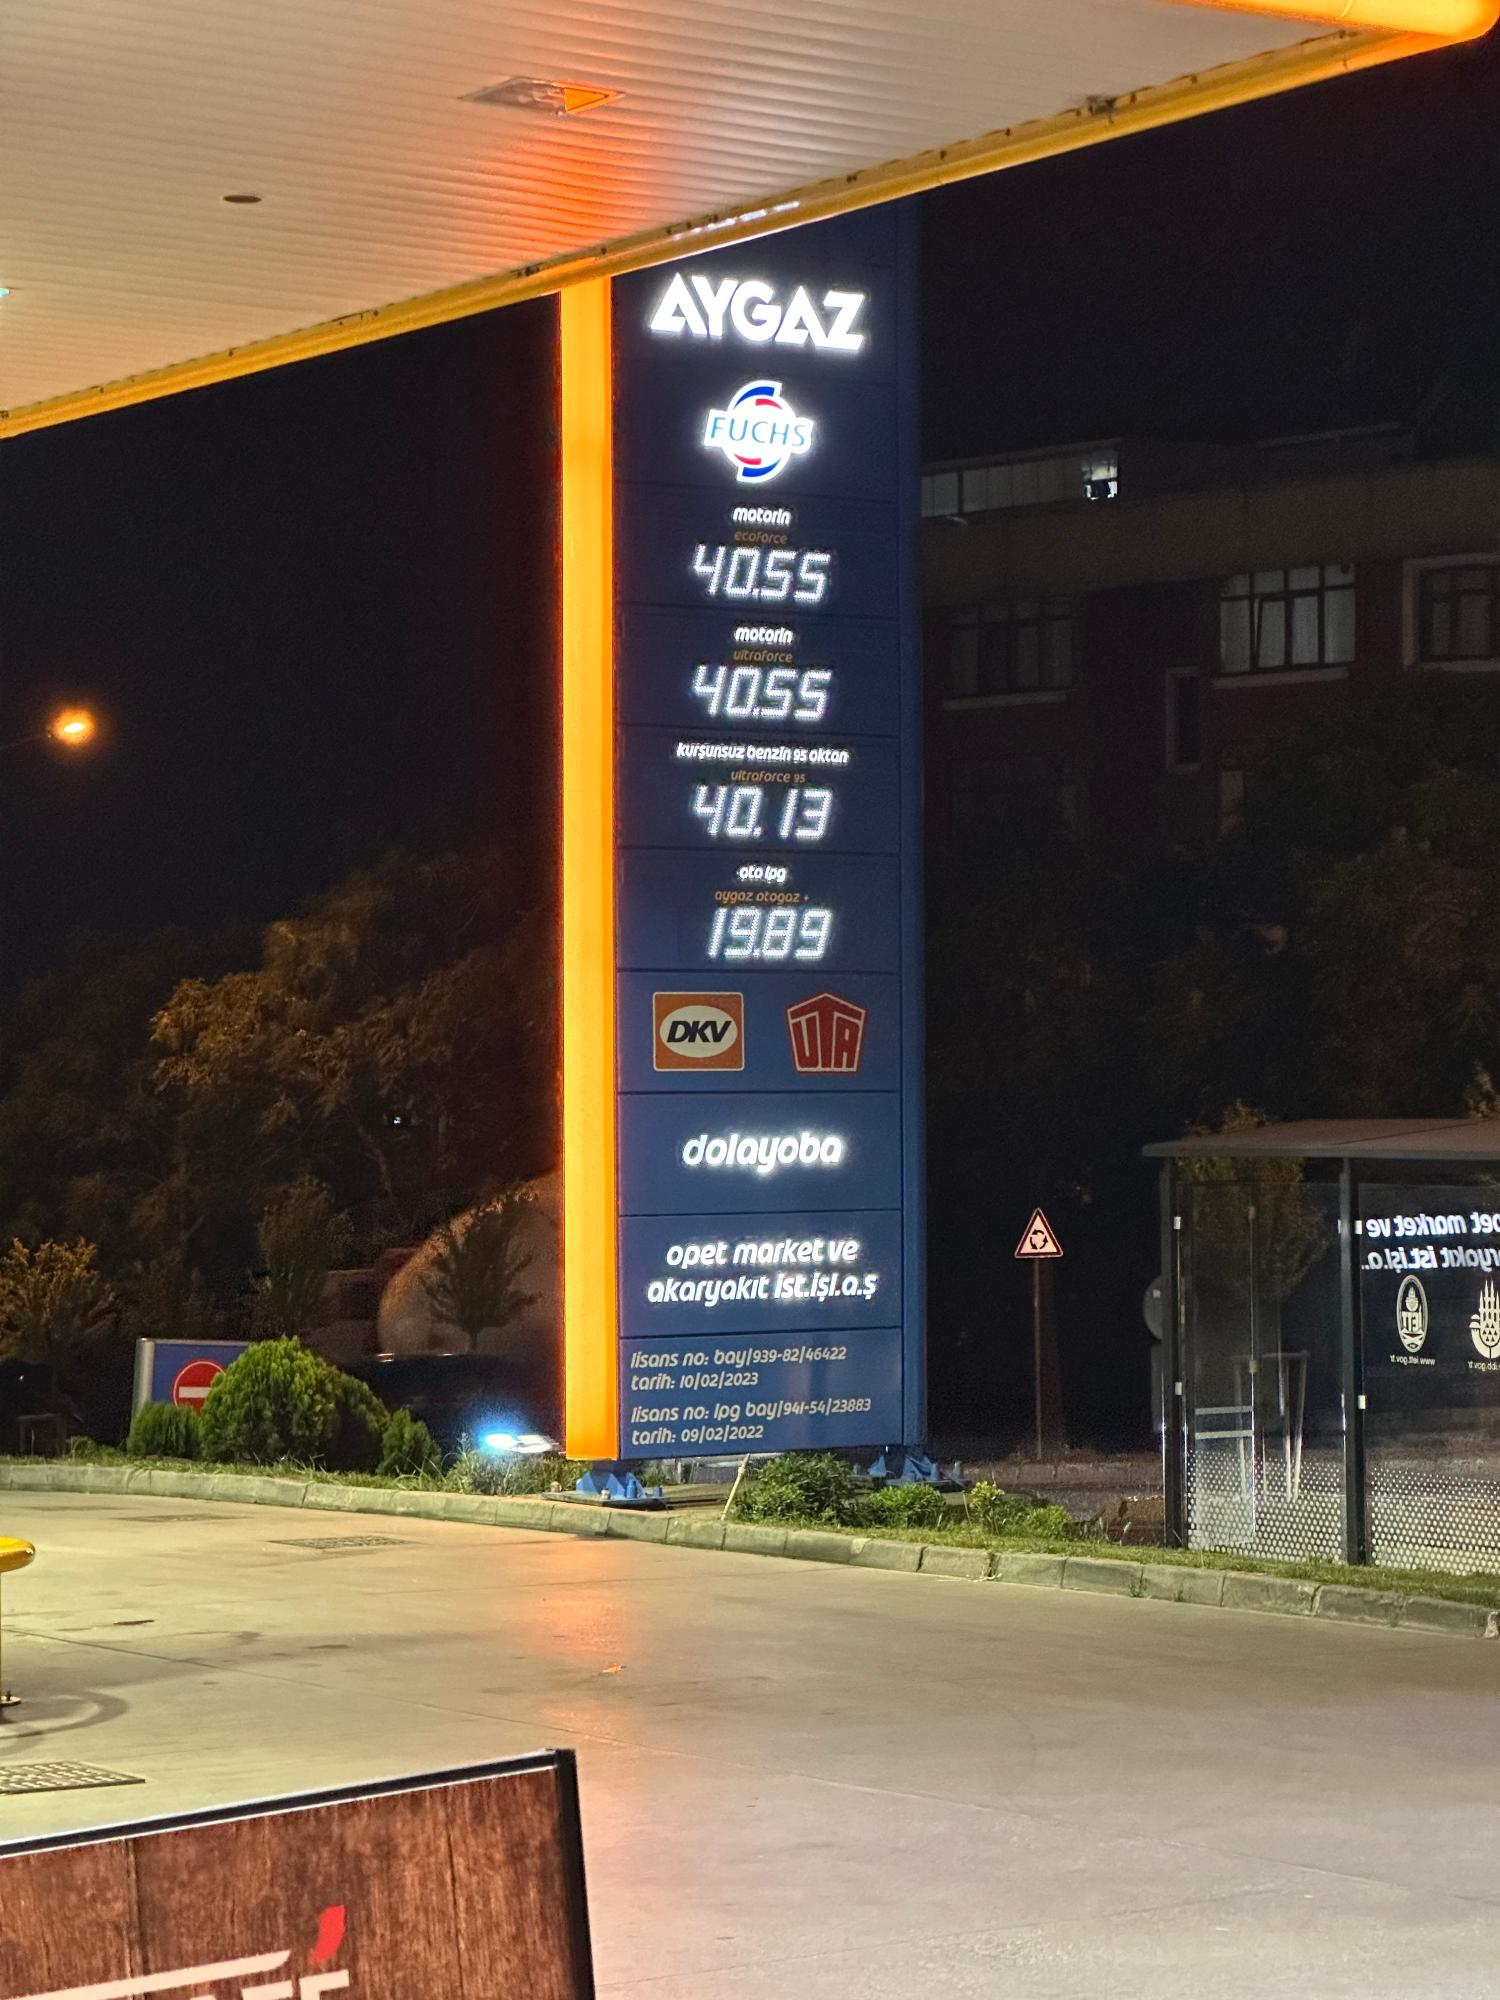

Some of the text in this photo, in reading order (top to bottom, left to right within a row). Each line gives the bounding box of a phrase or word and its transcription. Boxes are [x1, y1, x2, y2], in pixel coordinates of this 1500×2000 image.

[650, 272, 866, 351] AYGAZ
[710, 416, 808, 447] FUCHS
[733, 507, 791, 526] motorin
[734, 530, 788, 544] ecoforce
[693, 543, 832, 602] 40.55
[734, 626, 794, 644] motorin
[733, 650, 793, 663] ultraforce
[693, 665, 833, 719] 40.55
[676, 742, 849, 764] kurşunsuz benzin 95 oktan
[731, 770, 806, 783] ultraforce 95
[739, 865, 787, 883] oto lpg
[714, 890, 753, 903] aygaz
[756, 891, 800, 906] otogaz
[707, 906, 832, 959] 19.89
[666, 1020, 732, 1043] DKV
[787, 993, 866, 1072] UTA
[682, 1132, 842, 1173] dolayoba
[666, 1238, 859, 1269] opet market ve
[647, 1276, 769, 1307] akaryakıt
[631, 1346, 847, 1368] lisans no: bay/939-82/46422
[631, 1371, 759, 1391] tarih: 10/02/2023
[631, 1405, 679, 1423] lisans
[683, 1406, 709, 1420] no:
[713, 1403, 740, 1422] lpg
[631, 1425, 764, 1445] tarih: 09/02/2022
